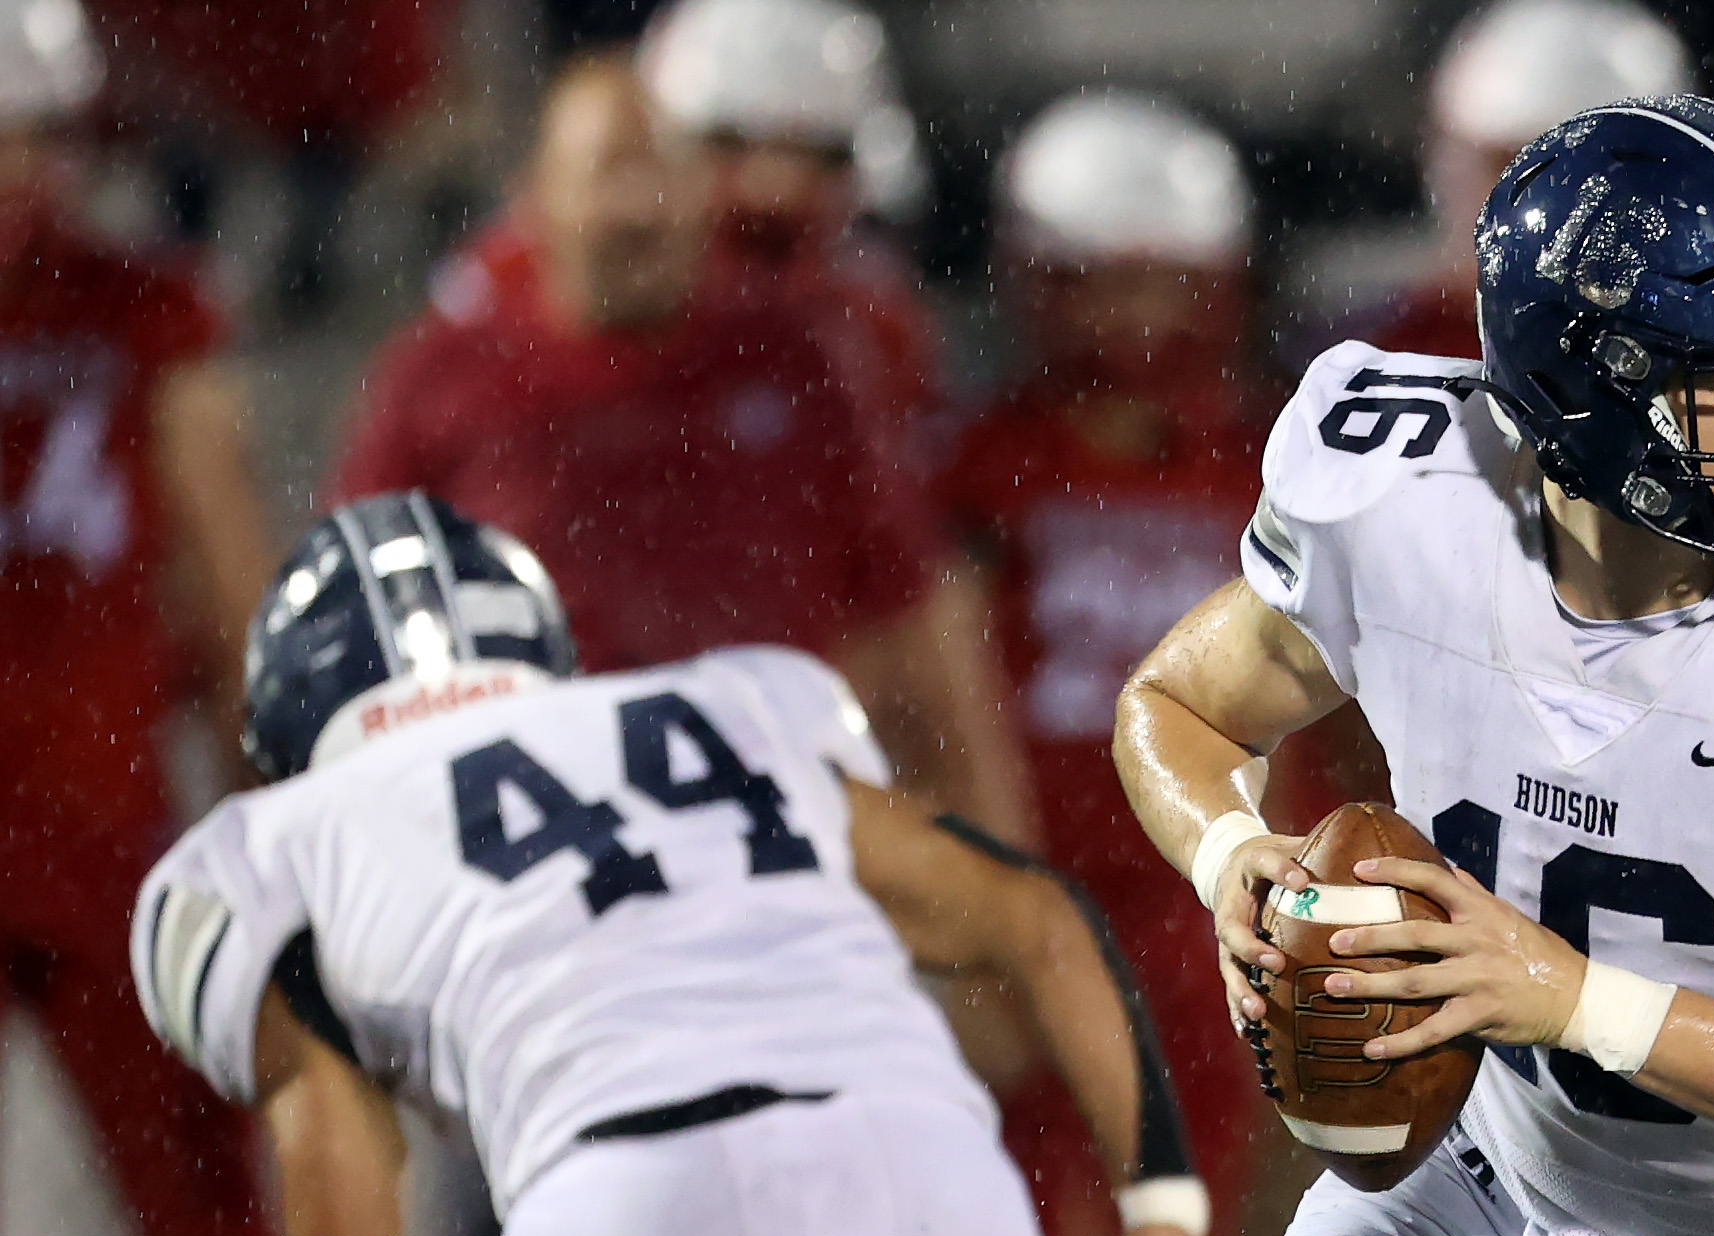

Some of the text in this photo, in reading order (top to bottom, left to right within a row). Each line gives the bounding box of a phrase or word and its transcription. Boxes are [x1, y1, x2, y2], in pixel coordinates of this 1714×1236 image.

[1318, 367, 1456, 459] 16
[449, 691, 822, 918] 44
[1513, 772, 1619, 838] HUDSON
